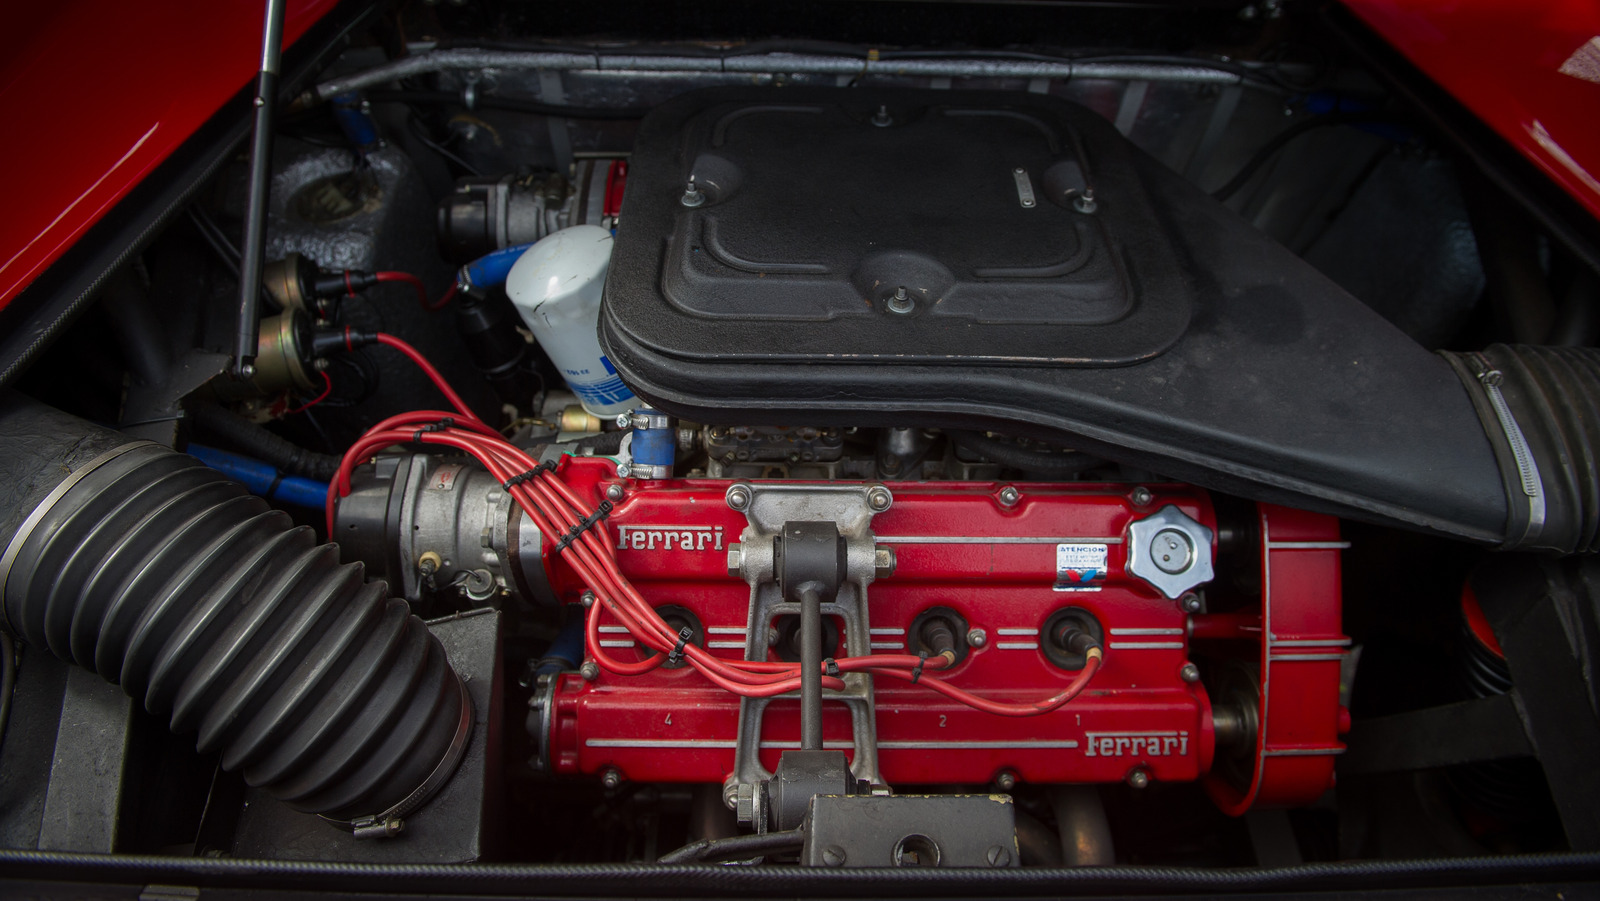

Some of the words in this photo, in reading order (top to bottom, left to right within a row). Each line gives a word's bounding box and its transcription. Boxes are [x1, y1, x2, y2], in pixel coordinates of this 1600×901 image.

[617, 525, 723, 550] Ferrari
[664, 712, 672, 726] 4
[939, 714, 947, 728] 2
[1075, 714, 1081, 726] 1
[1085, 731, 1188, 756] Ferrari
